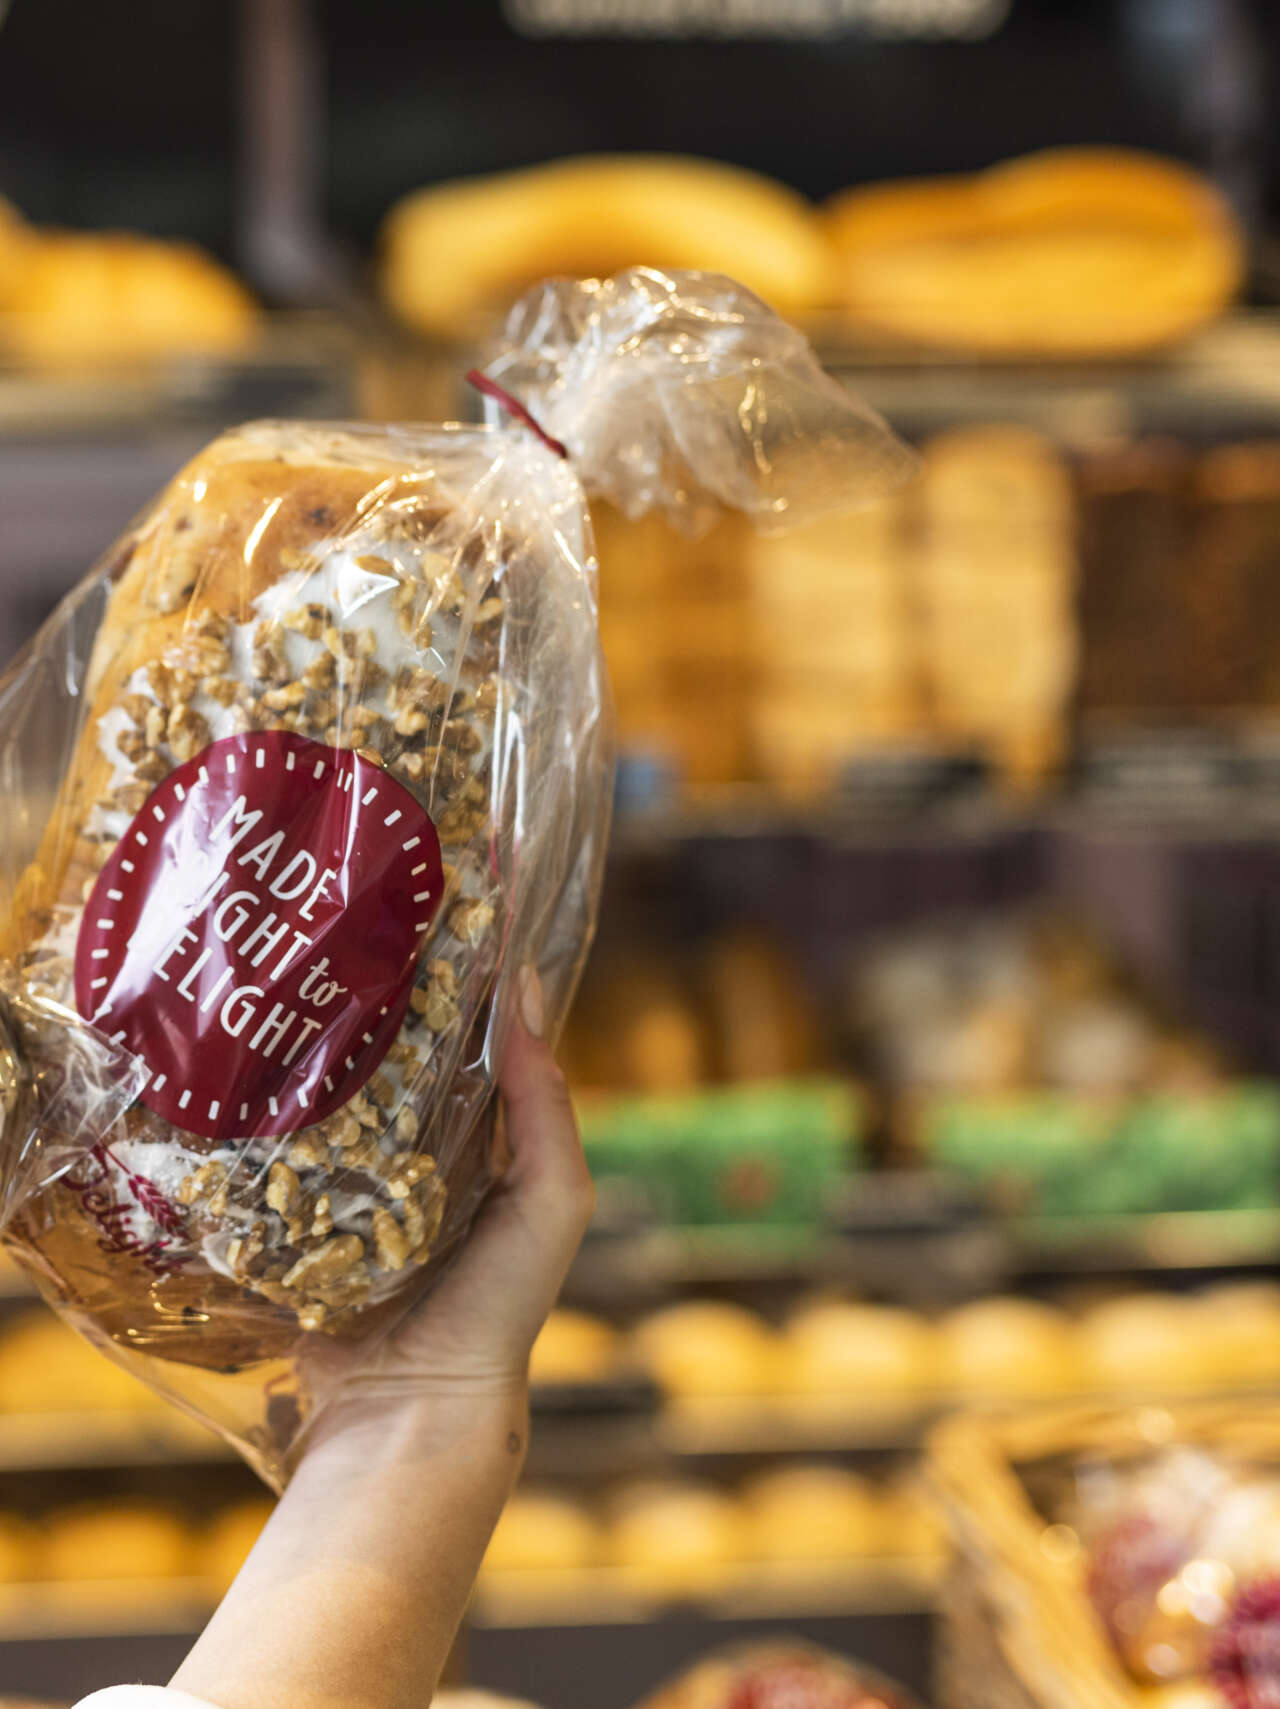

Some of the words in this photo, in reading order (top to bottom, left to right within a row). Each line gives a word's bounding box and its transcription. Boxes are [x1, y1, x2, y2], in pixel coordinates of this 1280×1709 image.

[209, 795, 337, 921] MADE
[151, 922, 322, 1067] ELIGHT
[193, 871, 313, 982] IGHT
[298, 957, 348, 1007] to
